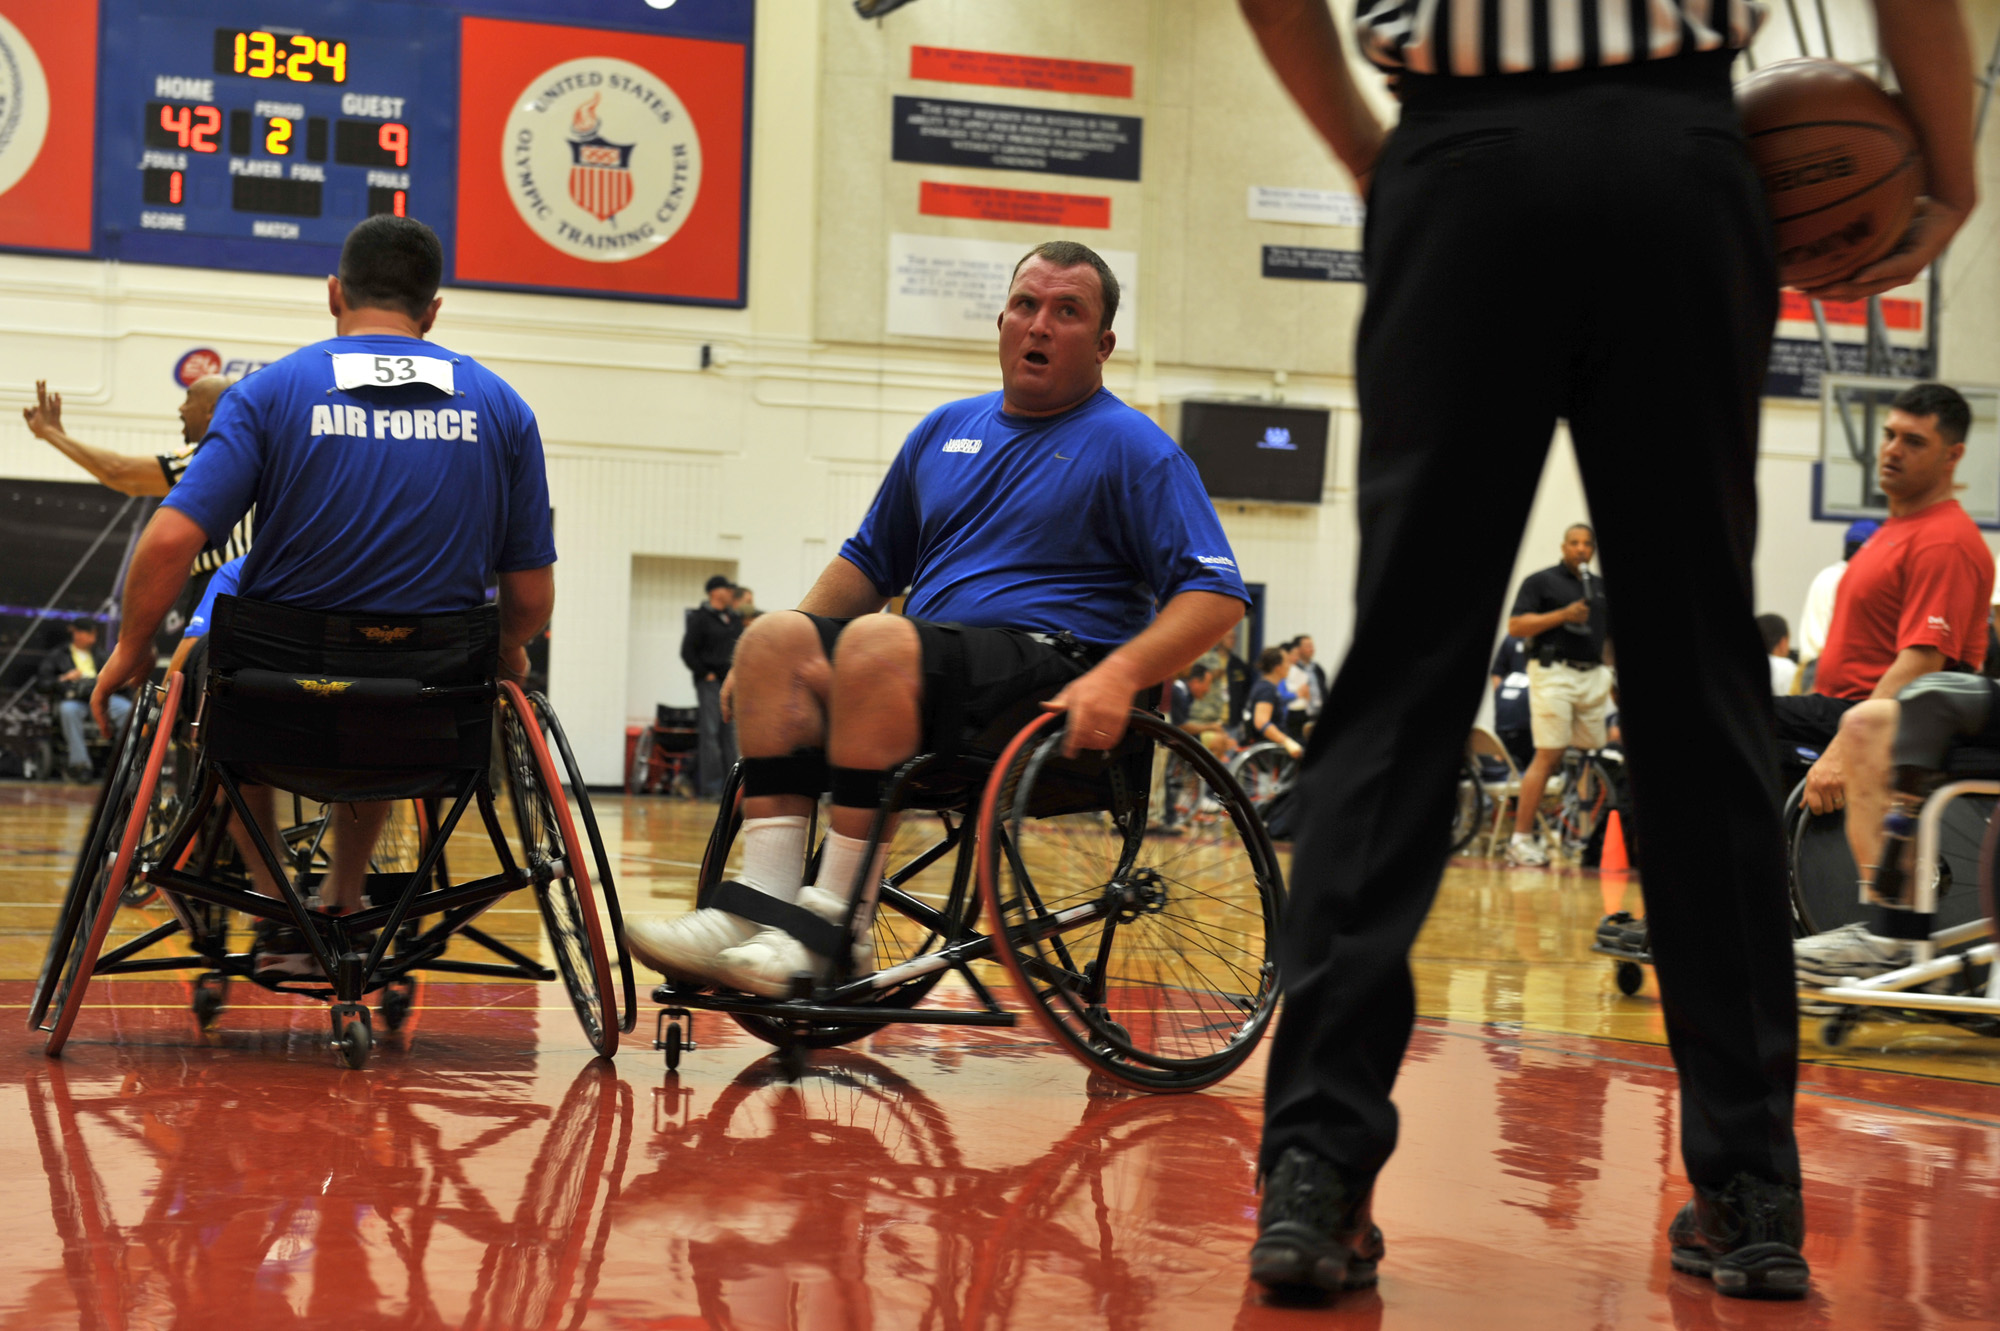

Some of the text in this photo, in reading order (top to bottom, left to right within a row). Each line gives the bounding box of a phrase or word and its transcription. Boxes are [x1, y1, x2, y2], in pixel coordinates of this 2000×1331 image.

[234, 31, 346, 82] 13:24
[155, 75, 214, 102] HOME
[534, 72, 673, 124] UNITED STATES
[254, 101, 304, 119] PERIOD
[342, 92, 405, 119] GUEST
[160, 105, 222, 153] 42
[265, 116, 292, 155] 2
[378, 122, 409, 167] 9
[142, 151, 187, 170] FOULS
[229, 158, 326, 183] PLAYER FOUL
[169, 171, 182, 204] 1
[366, 170, 410, 190] FOULS
[516, 129, 688, 249] OLYMPIC TRAINING CENTER
[393, 190, 406, 218] 1
[140, 211, 186, 231] SCORE
[253, 219, 299, 240] MATCH
[374, 356, 417, 383] 53
[311, 404, 478, 443] AIR FORCE
